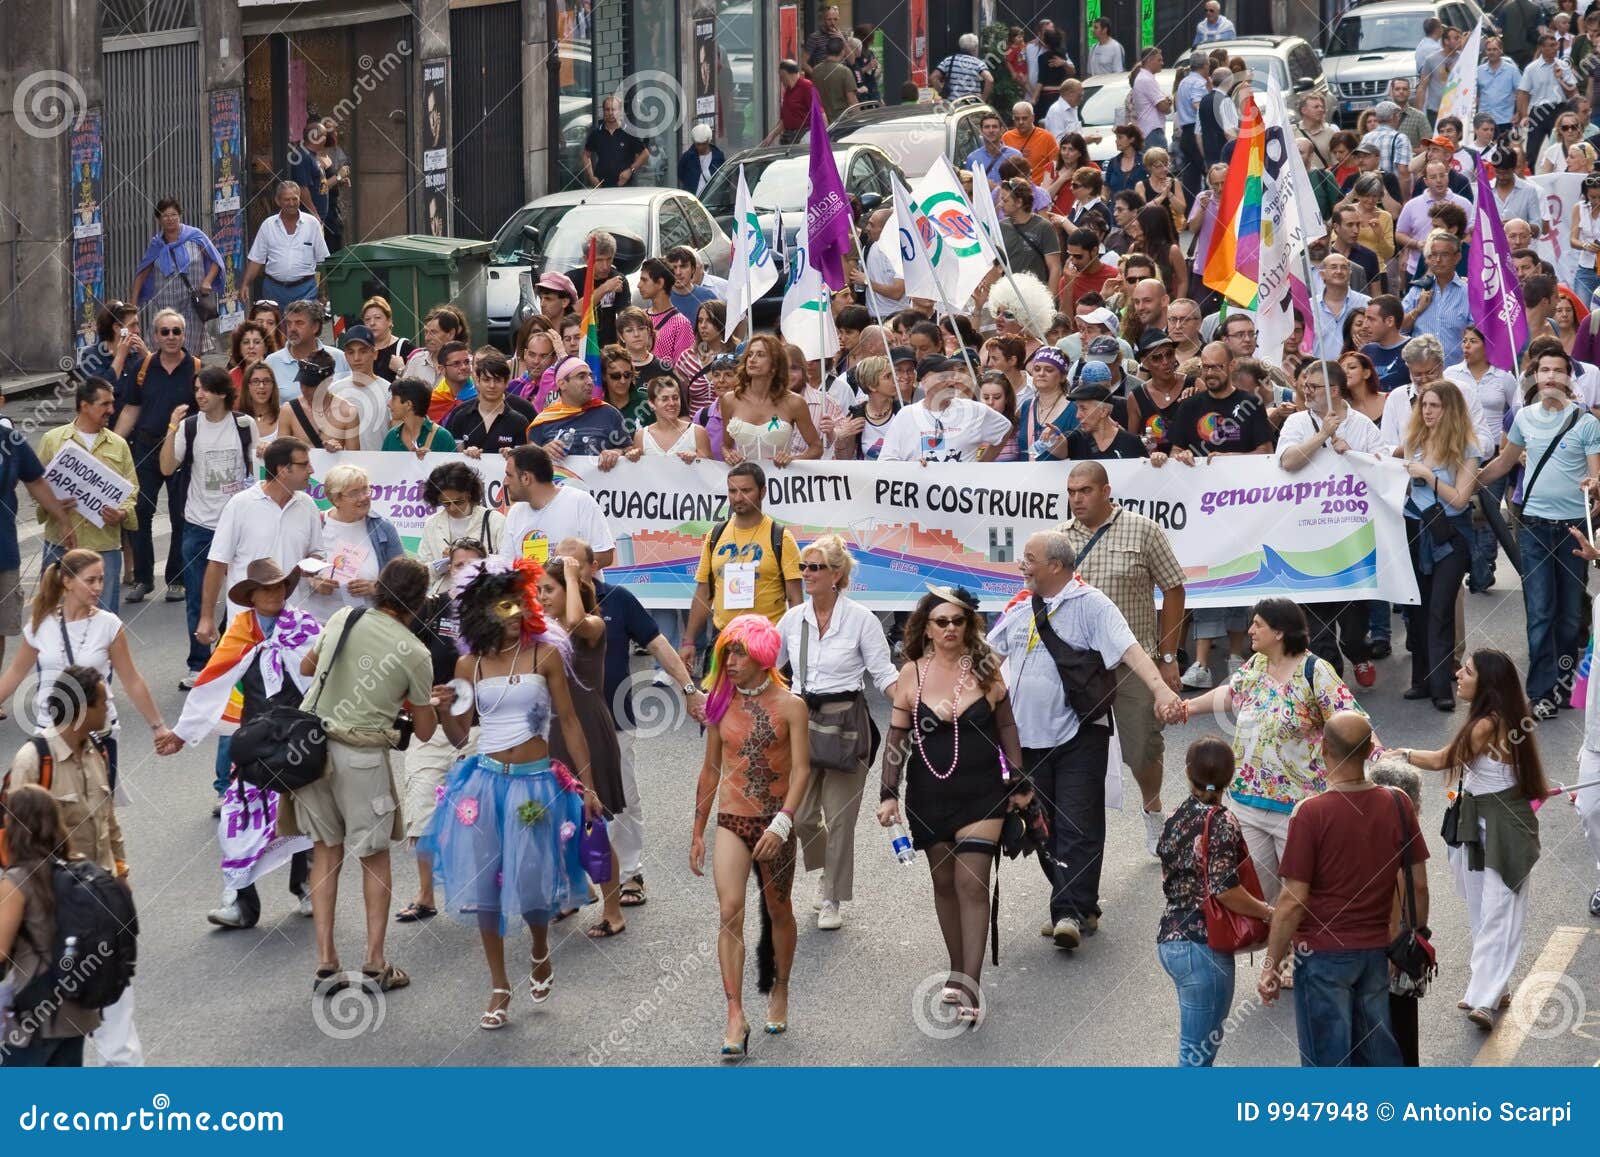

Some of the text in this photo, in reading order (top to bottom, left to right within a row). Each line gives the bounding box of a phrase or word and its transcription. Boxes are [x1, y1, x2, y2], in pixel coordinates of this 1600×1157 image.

[590, 489, 731, 522] GUAGLIANZ
[768, 475, 852, 506] DIRITTI
[875, 479, 919, 508] PER
[926, 484, 1059, 520] COSTRUIRE
[1109, 497, 1187, 530] TURO
[1201, 474, 1368, 515] genovapride
[1321, 499, 1369, 515] 2009
